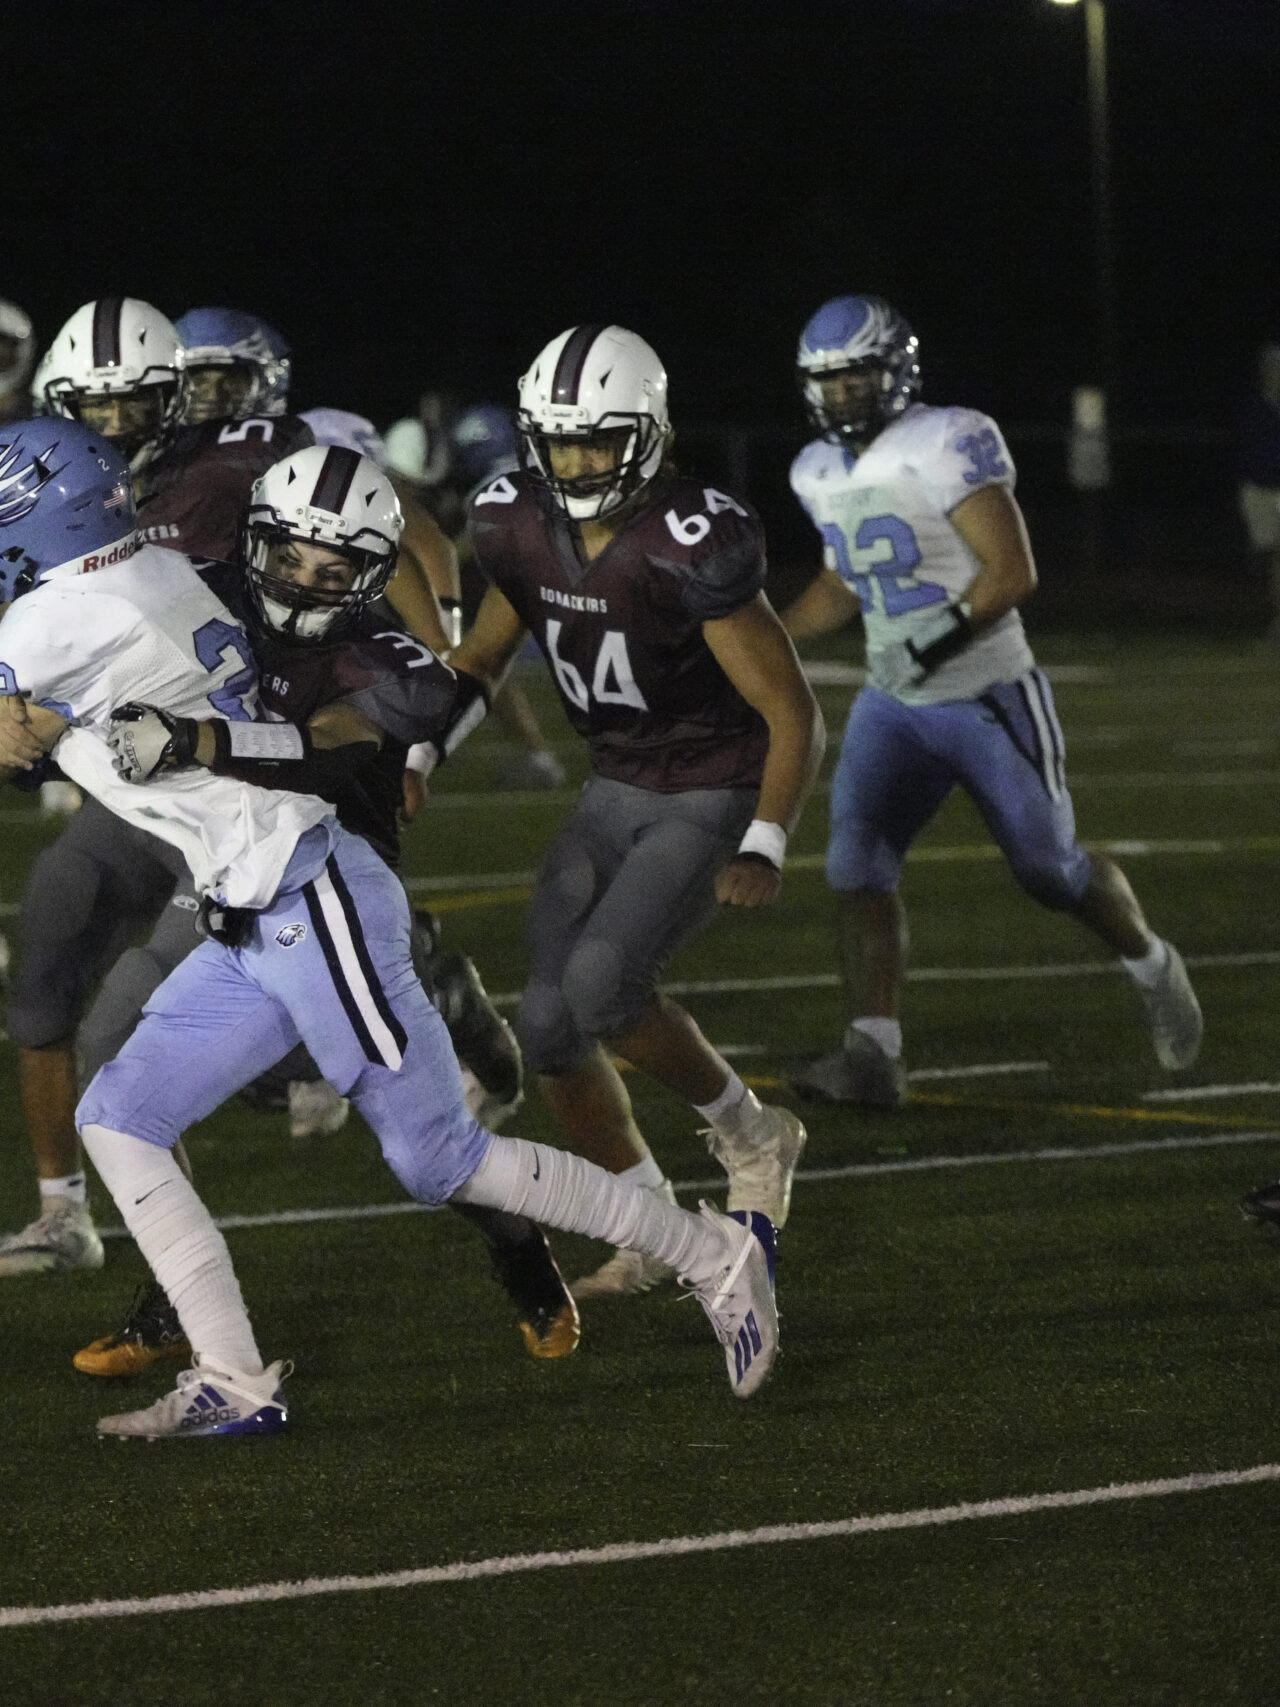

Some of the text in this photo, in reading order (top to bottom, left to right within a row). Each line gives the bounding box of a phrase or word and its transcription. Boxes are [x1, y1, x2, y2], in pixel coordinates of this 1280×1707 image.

[97, 458, 110, 472] 2
[665, 488, 749, 546] 64
[545, 619, 649, 714] 64
[180, 1407, 241, 1428] adidas
